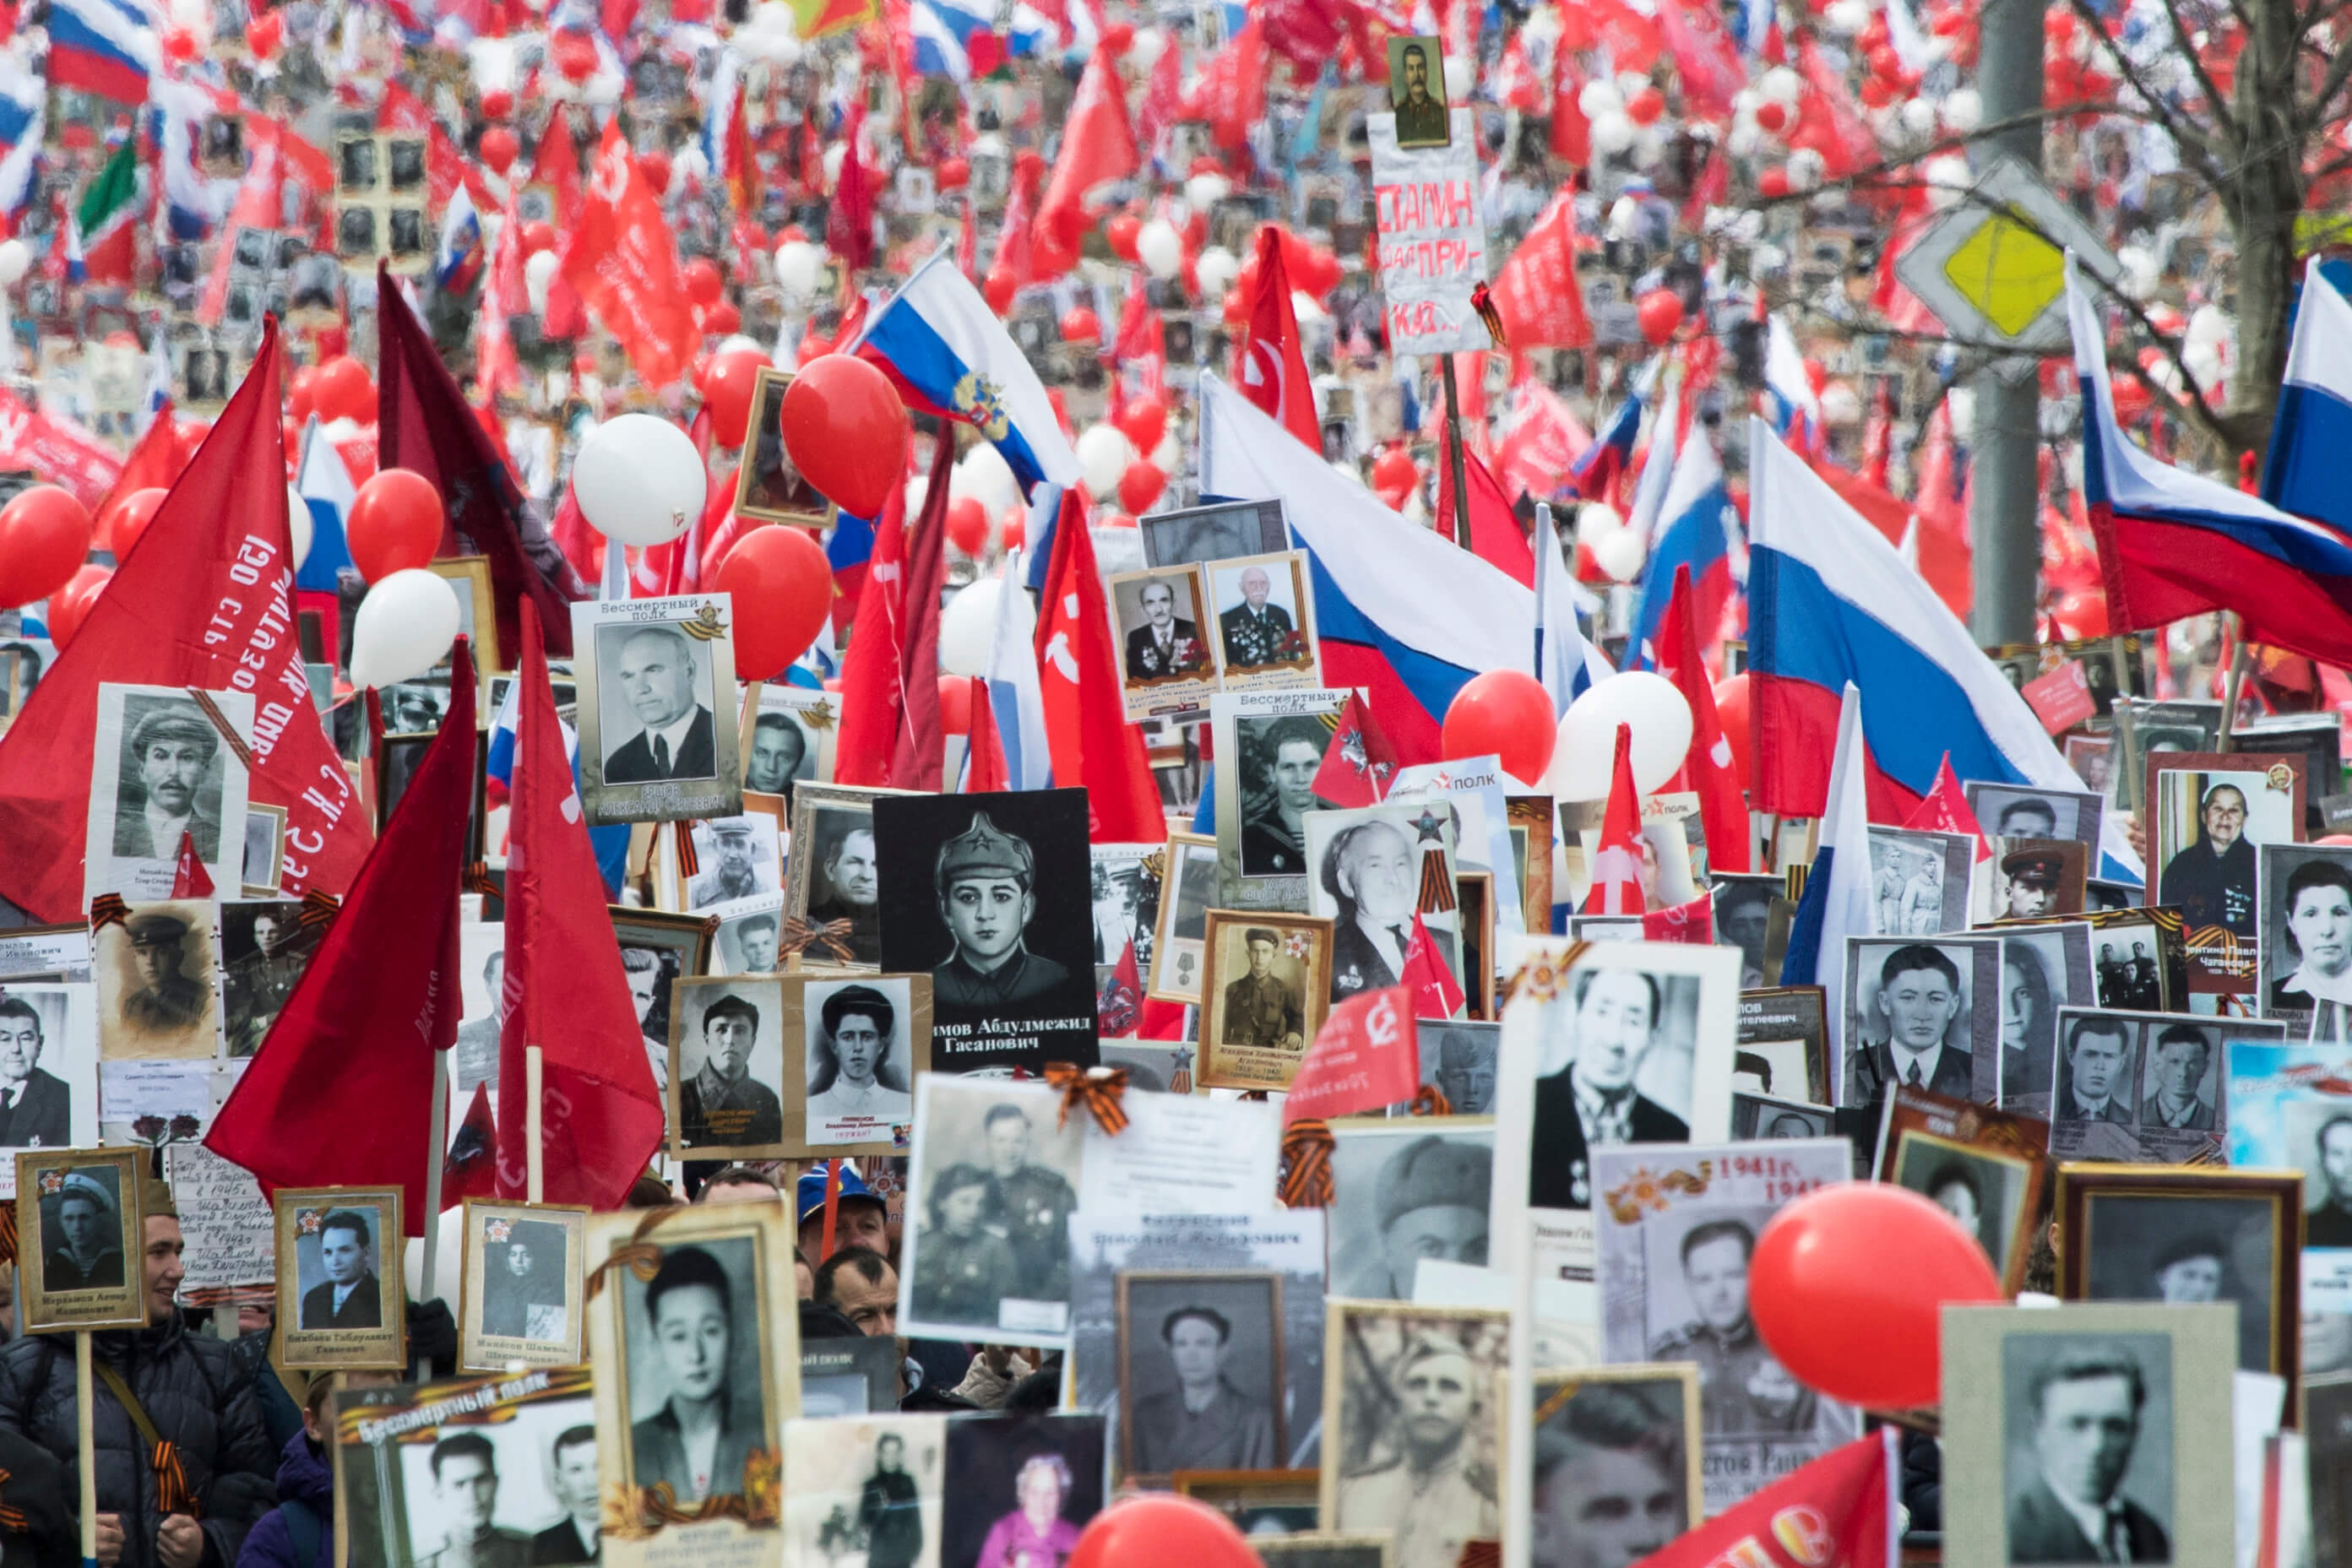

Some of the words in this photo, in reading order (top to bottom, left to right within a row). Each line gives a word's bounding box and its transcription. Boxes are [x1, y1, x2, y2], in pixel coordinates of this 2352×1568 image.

[1373, 180, 1474, 233] СТАЛИН
[600, 598, 698, 614] Бессмертный
[1240, 691, 1336, 706] Бессмертный
[976, 1017, 1091, 1037] Абдулмежид
[944, 1037, 1040, 1054] Гасанович
